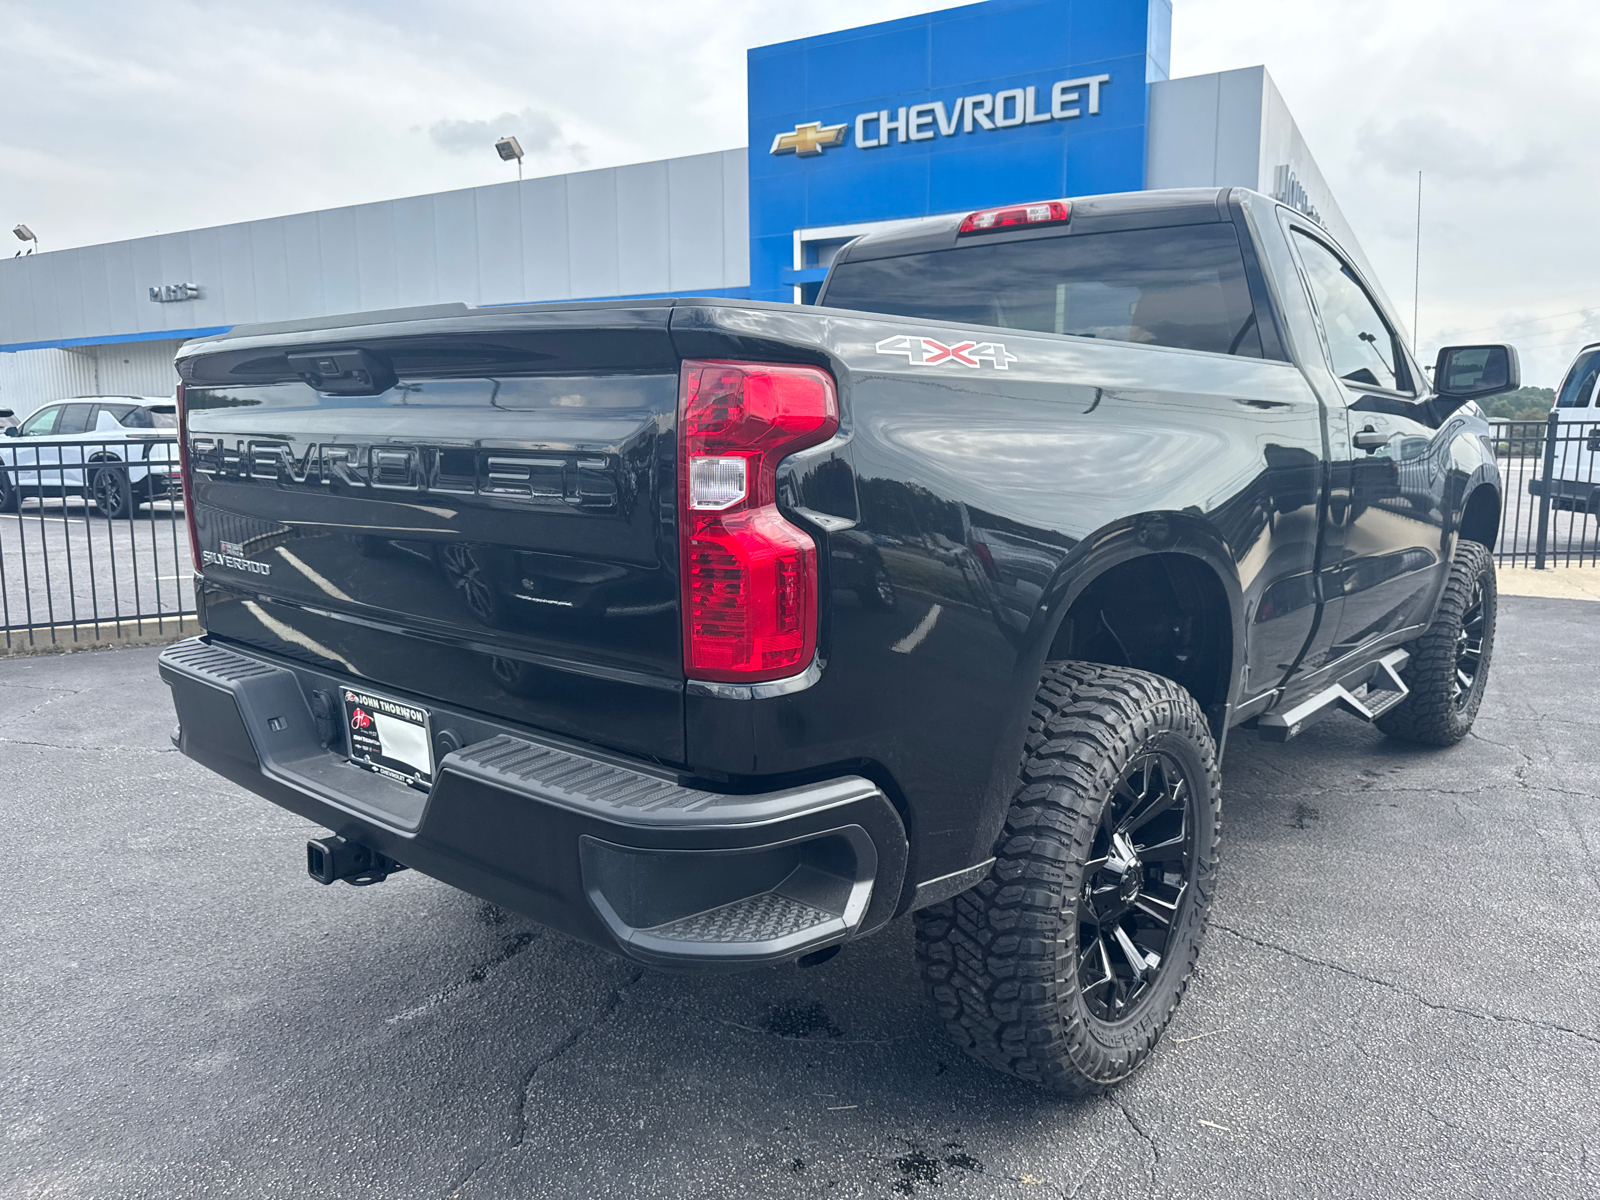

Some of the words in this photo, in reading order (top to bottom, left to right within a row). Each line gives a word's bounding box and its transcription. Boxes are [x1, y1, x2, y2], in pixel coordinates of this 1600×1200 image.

[855, 73, 1110, 149] CHEVROLET
[192, 438, 614, 507] CHEVROLET
[202, 550, 271, 576] SILVERADO
[359, 694, 380, 709] JOHN
[380, 700, 423, 722] THORNTON
[380, 768, 405, 782] CHEVROLET
